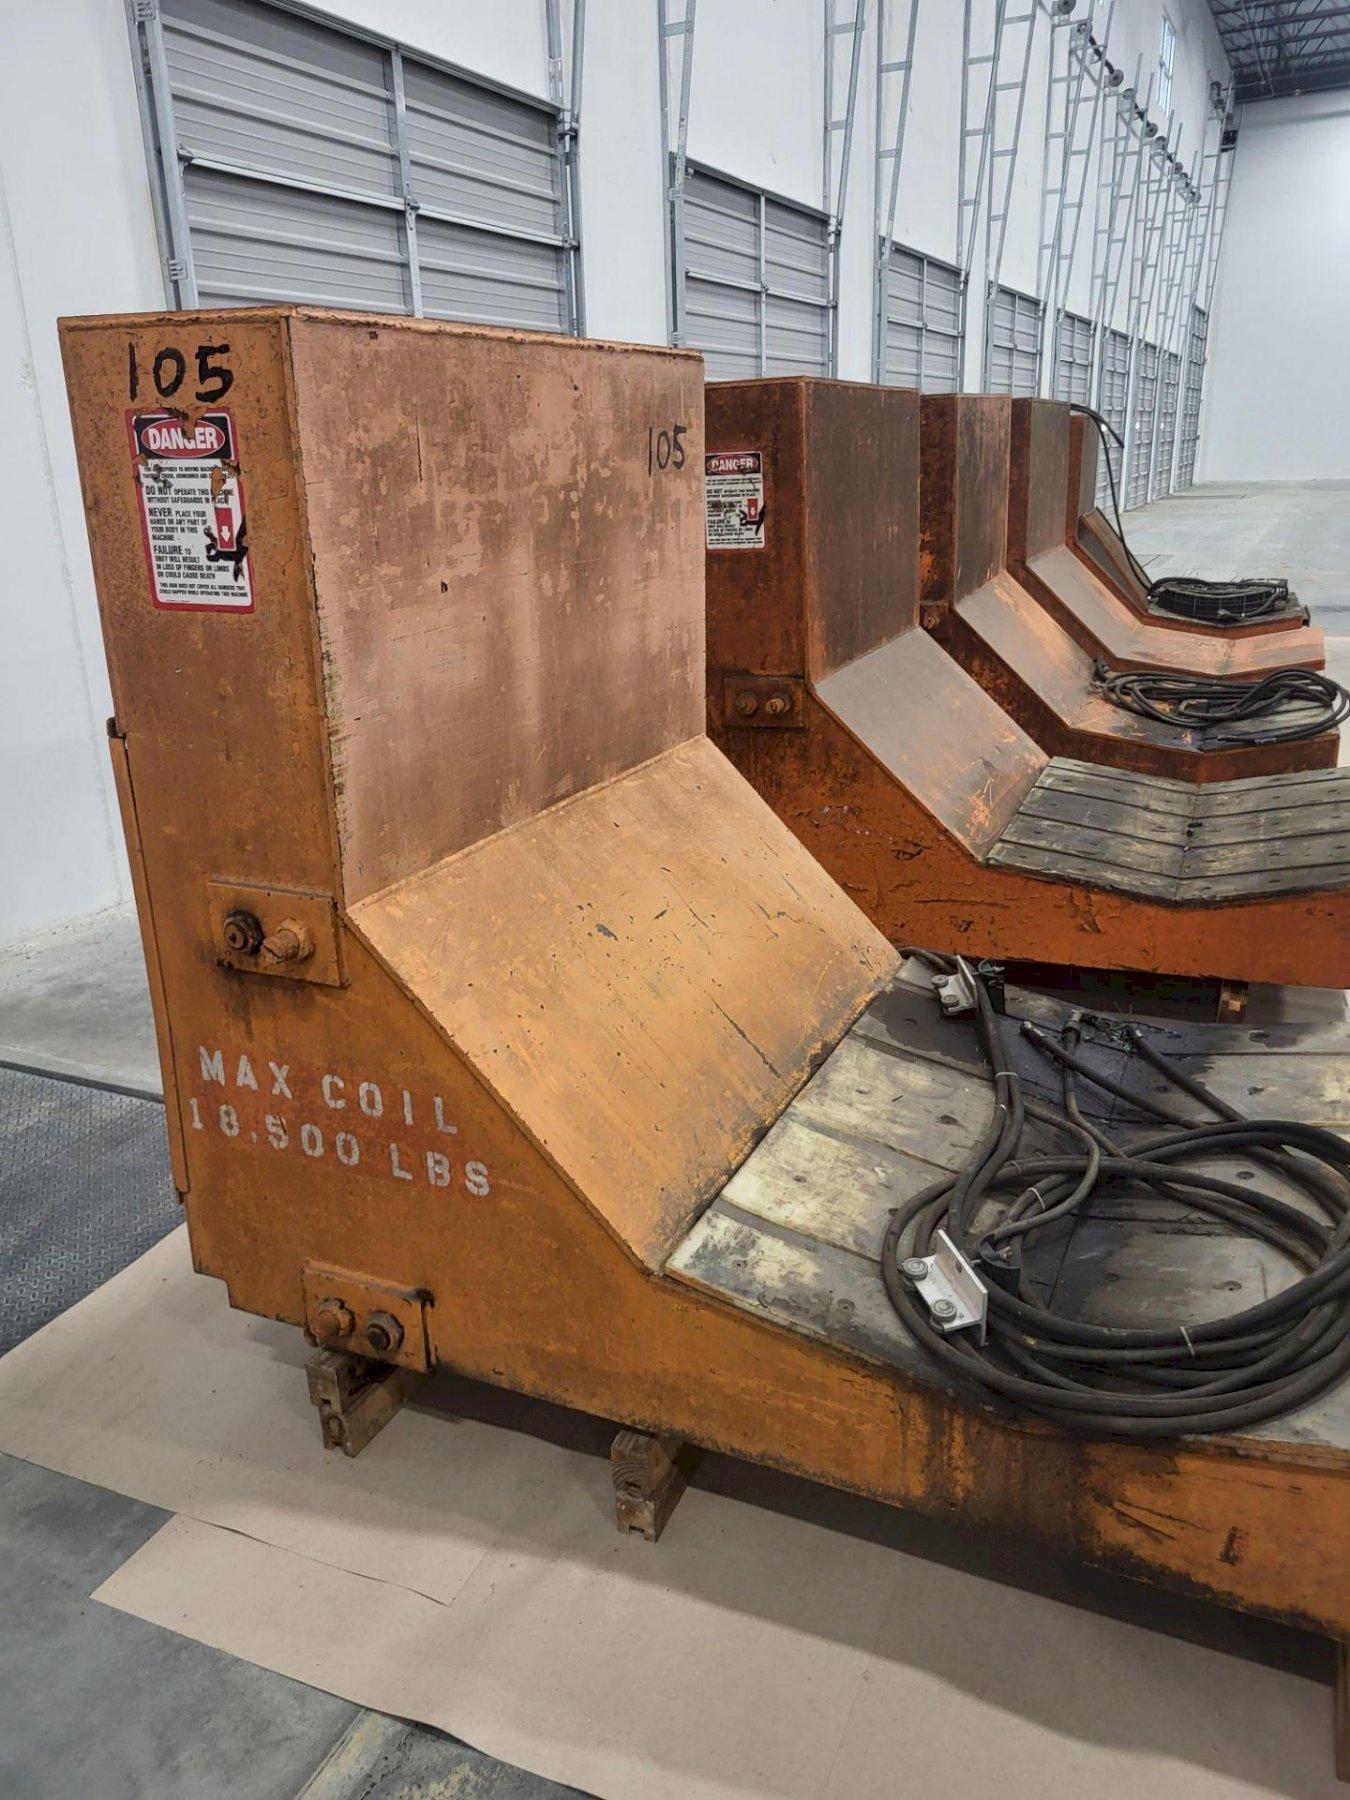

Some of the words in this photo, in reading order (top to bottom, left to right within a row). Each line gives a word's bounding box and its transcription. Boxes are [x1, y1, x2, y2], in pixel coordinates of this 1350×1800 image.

[128, 342, 233, 402] 105
[148, 427, 218, 449] DANGER
[648, 424, 687, 477] 105
[145, 486, 156, 495] DO
[157, 485, 171, 495] NOT
[173, 488, 197, 496] OPERATE
[197, 488, 209, 496] THIS
[148, 507, 172, 517] NEVER
[192, 510, 206, 518] YOUR
[150, 518, 166, 526] HANDS
[176, 518, 186, 526] ANY
[186, 526, 198, 534] THIS
[154, 545, 183, 555] FAILURE
[199, 1046, 292, 1099] MAX
[321, 1074, 458, 1135] COIL
[390, 1142, 491, 1197] LBS
